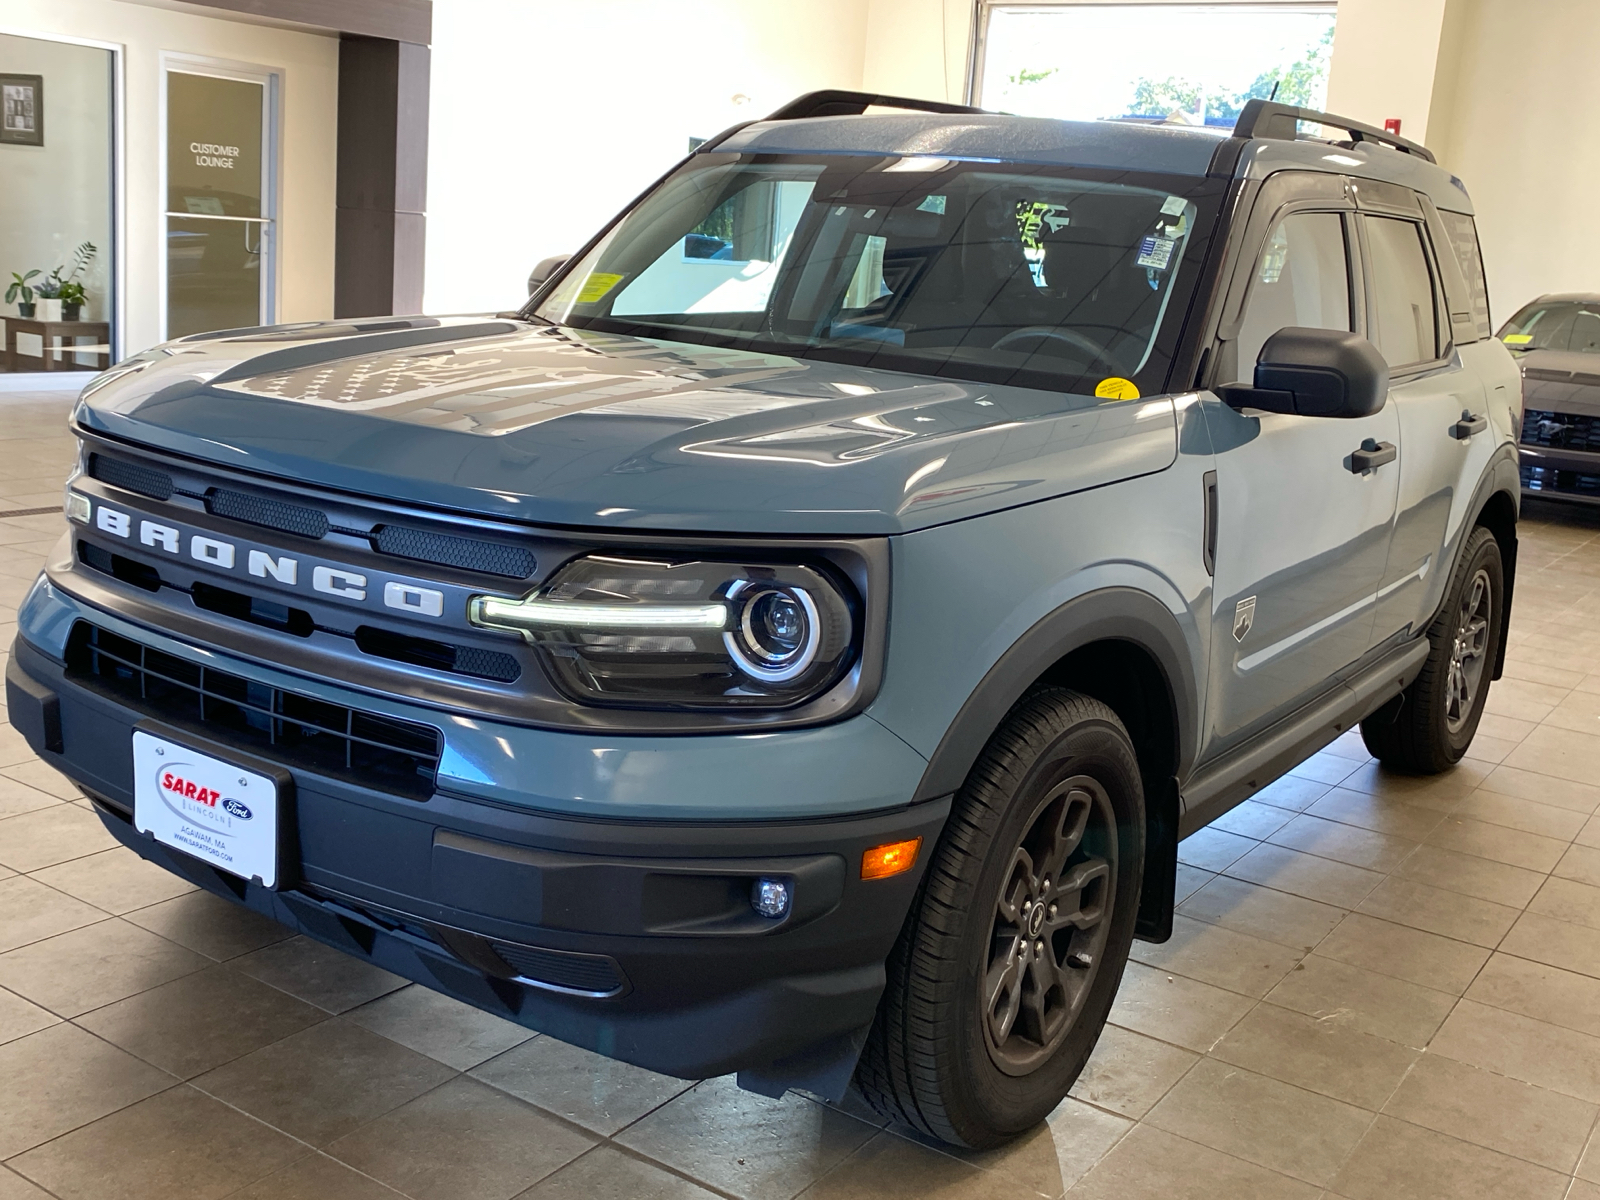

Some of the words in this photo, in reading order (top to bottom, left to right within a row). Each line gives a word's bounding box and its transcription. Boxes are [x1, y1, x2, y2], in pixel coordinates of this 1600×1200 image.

[190, 142, 239, 157] CUSTOMER
[196, 155, 234, 168] LOUNGE
[97, 506, 444, 617] BRONCO
[162, 772, 220, 807] SARAT
[188, 803, 225, 823] LINCOLN
[226, 800, 248, 818] Ford
[174, 832, 233, 862] WWW.SARATFORD.COM
[180, 825, 213, 846] AGAWAM,
[214, 839, 226, 850] MA
